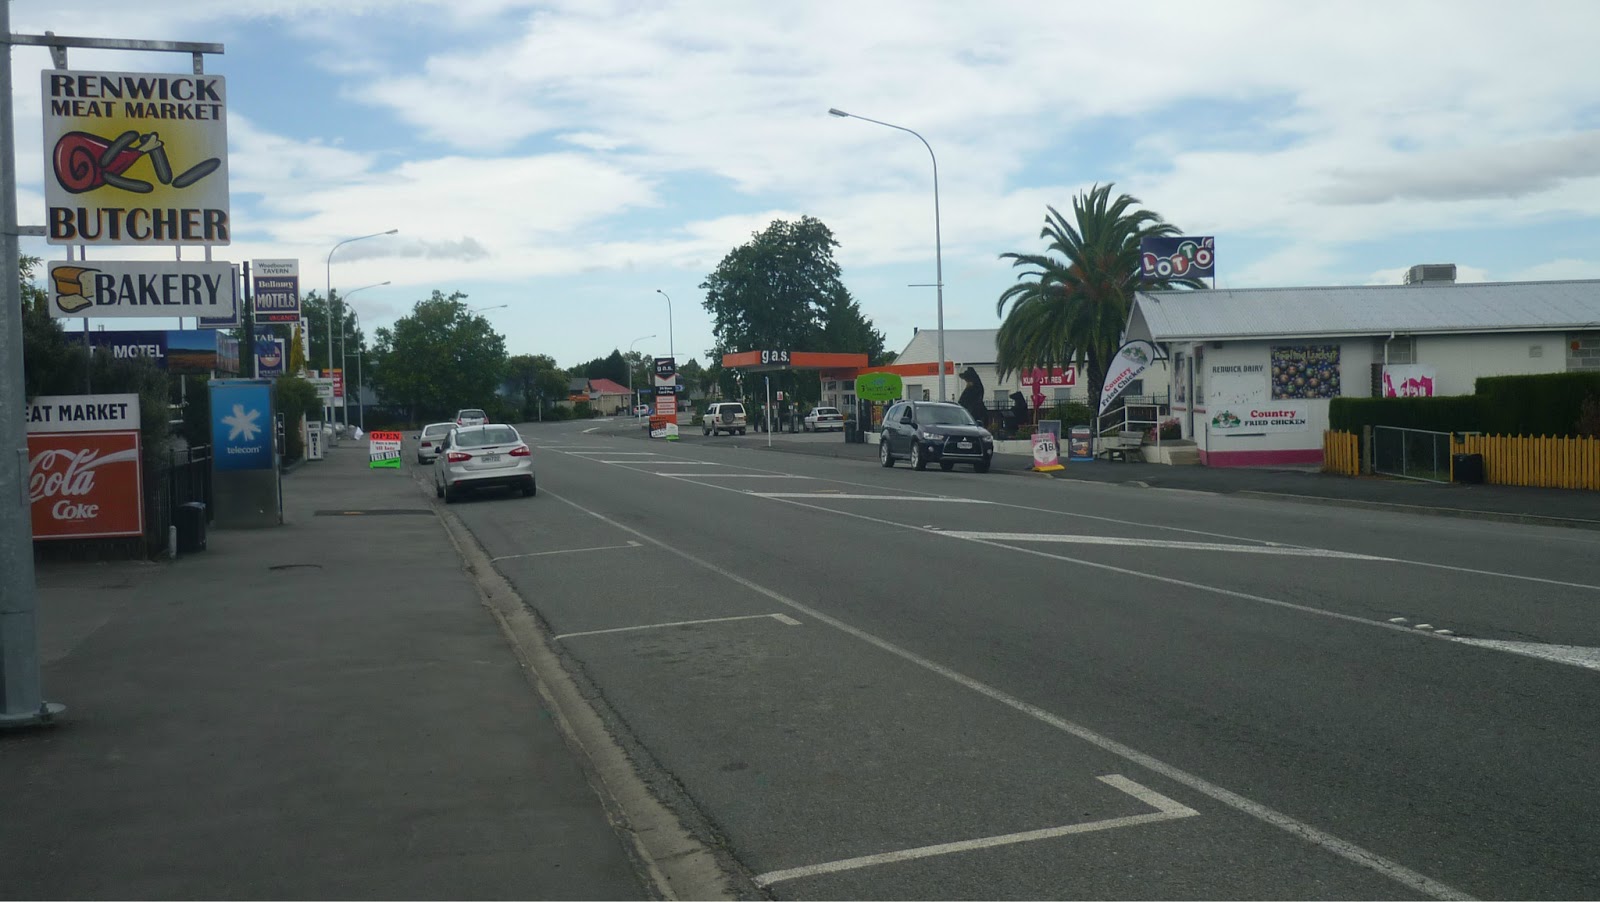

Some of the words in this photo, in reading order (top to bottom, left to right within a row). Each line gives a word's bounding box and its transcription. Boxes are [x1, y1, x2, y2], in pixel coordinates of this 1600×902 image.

[50, 74, 221, 102] RENWICK
[51, 99, 116, 118] MEAT
[124, 101, 223, 121] MARKET
[49, 206, 229, 241] BUTCHER
[1143, 244, 1211, 276] LOTTO
[94, 273, 222, 306] BAKERY
[258, 280, 294, 289] Bellamy
[257, 293, 296, 308] MOTELS
[254, 334, 274, 342] TAB
[113, 344, 164, 359] MOTEL
[1243, 365, 1264, 373] DAIRY
[1100, 388, 1119, 407] Fried
[1117, 365, 1145, 389] Chicken
[1104, 367, 1132, 392] Country
[59, 403, 128, 421] MARKET
[1250, 410, 1297, 419] Country
[372, 432, 400, 440] OPEN
[227, 444, 260, 454] telecom
[52, 499, 99, 520] Coke
